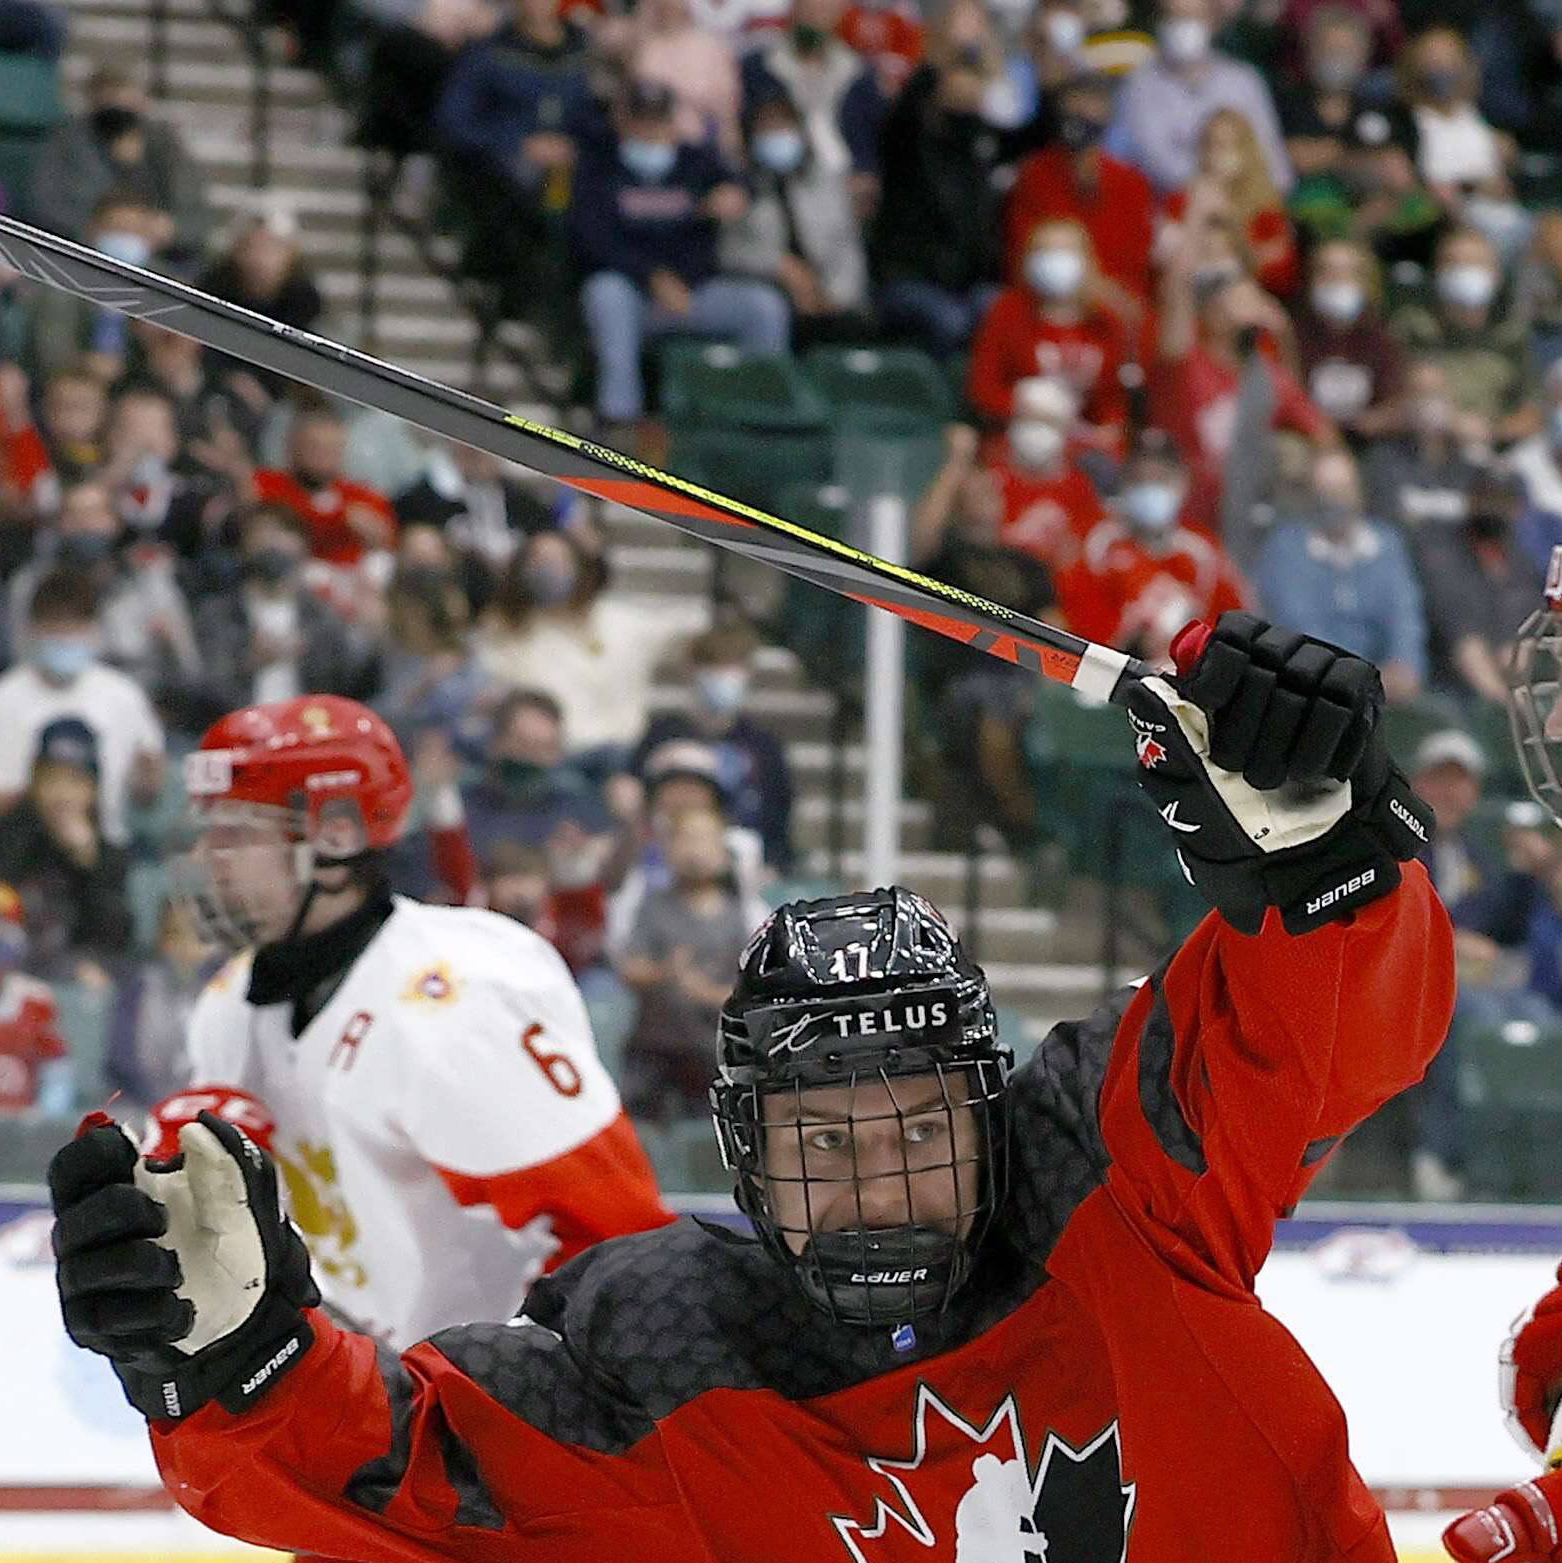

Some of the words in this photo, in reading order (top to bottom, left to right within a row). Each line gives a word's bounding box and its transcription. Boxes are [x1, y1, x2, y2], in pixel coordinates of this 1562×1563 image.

[1390, 799, 1430, 843] CANADA
[1306, 868, 1376, 915] BAUER
[828, 943, 869, 982] 17
[326, 1011, 373, 1072] A
[833, 1002, 948, 1039] TELUS
[520, 1021, 582, 1098] 6
[241, 1337, 299, 1395] BAUER
